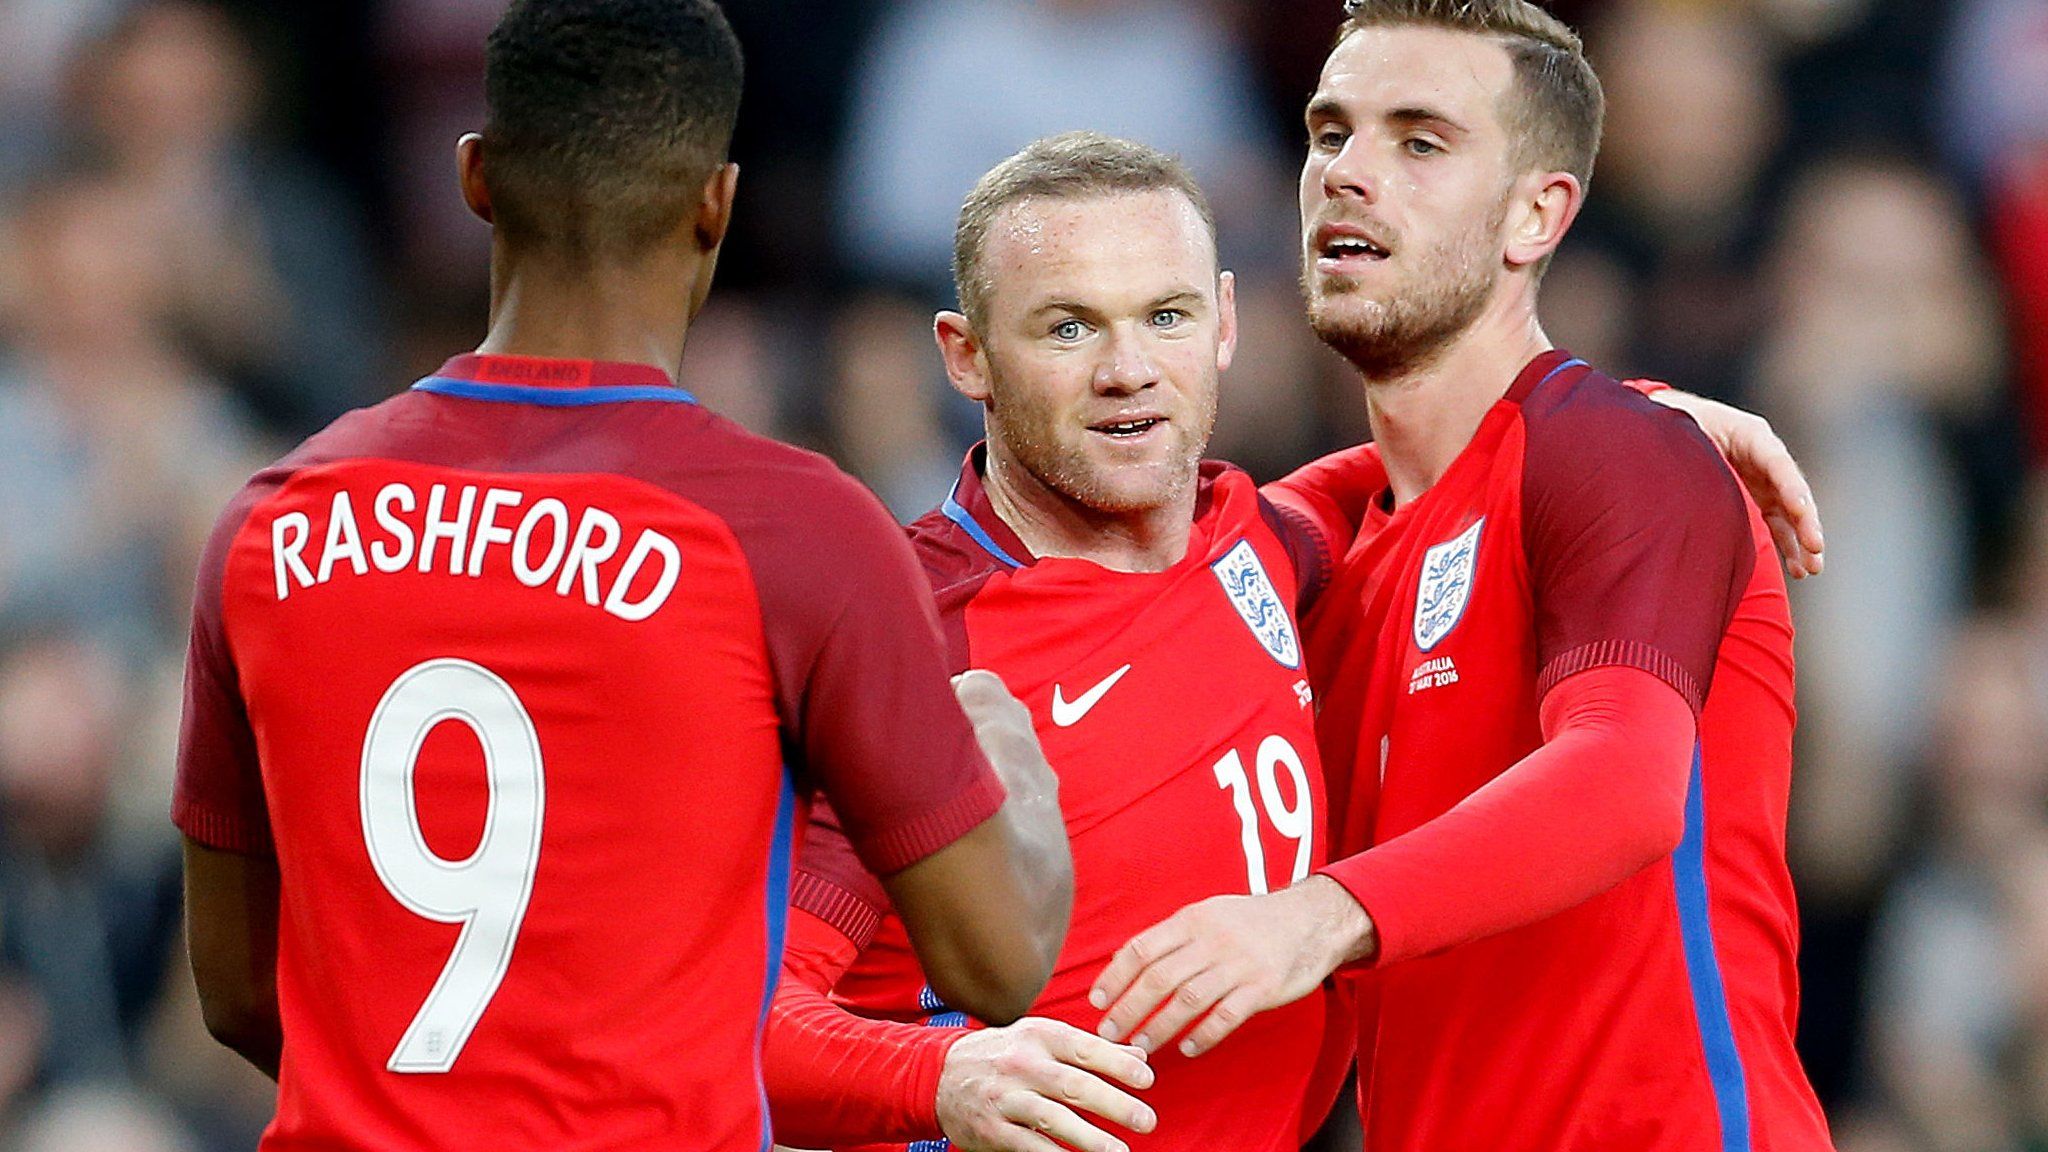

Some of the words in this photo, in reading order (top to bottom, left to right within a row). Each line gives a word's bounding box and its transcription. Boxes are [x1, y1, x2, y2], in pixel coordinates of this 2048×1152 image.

[271, 482, 682, 622] RASHFORD
[1434, 669, 1459, 687] 2016
[359, 656, 546, 1073] 9
[1212, 734, 1314, 895] 19
